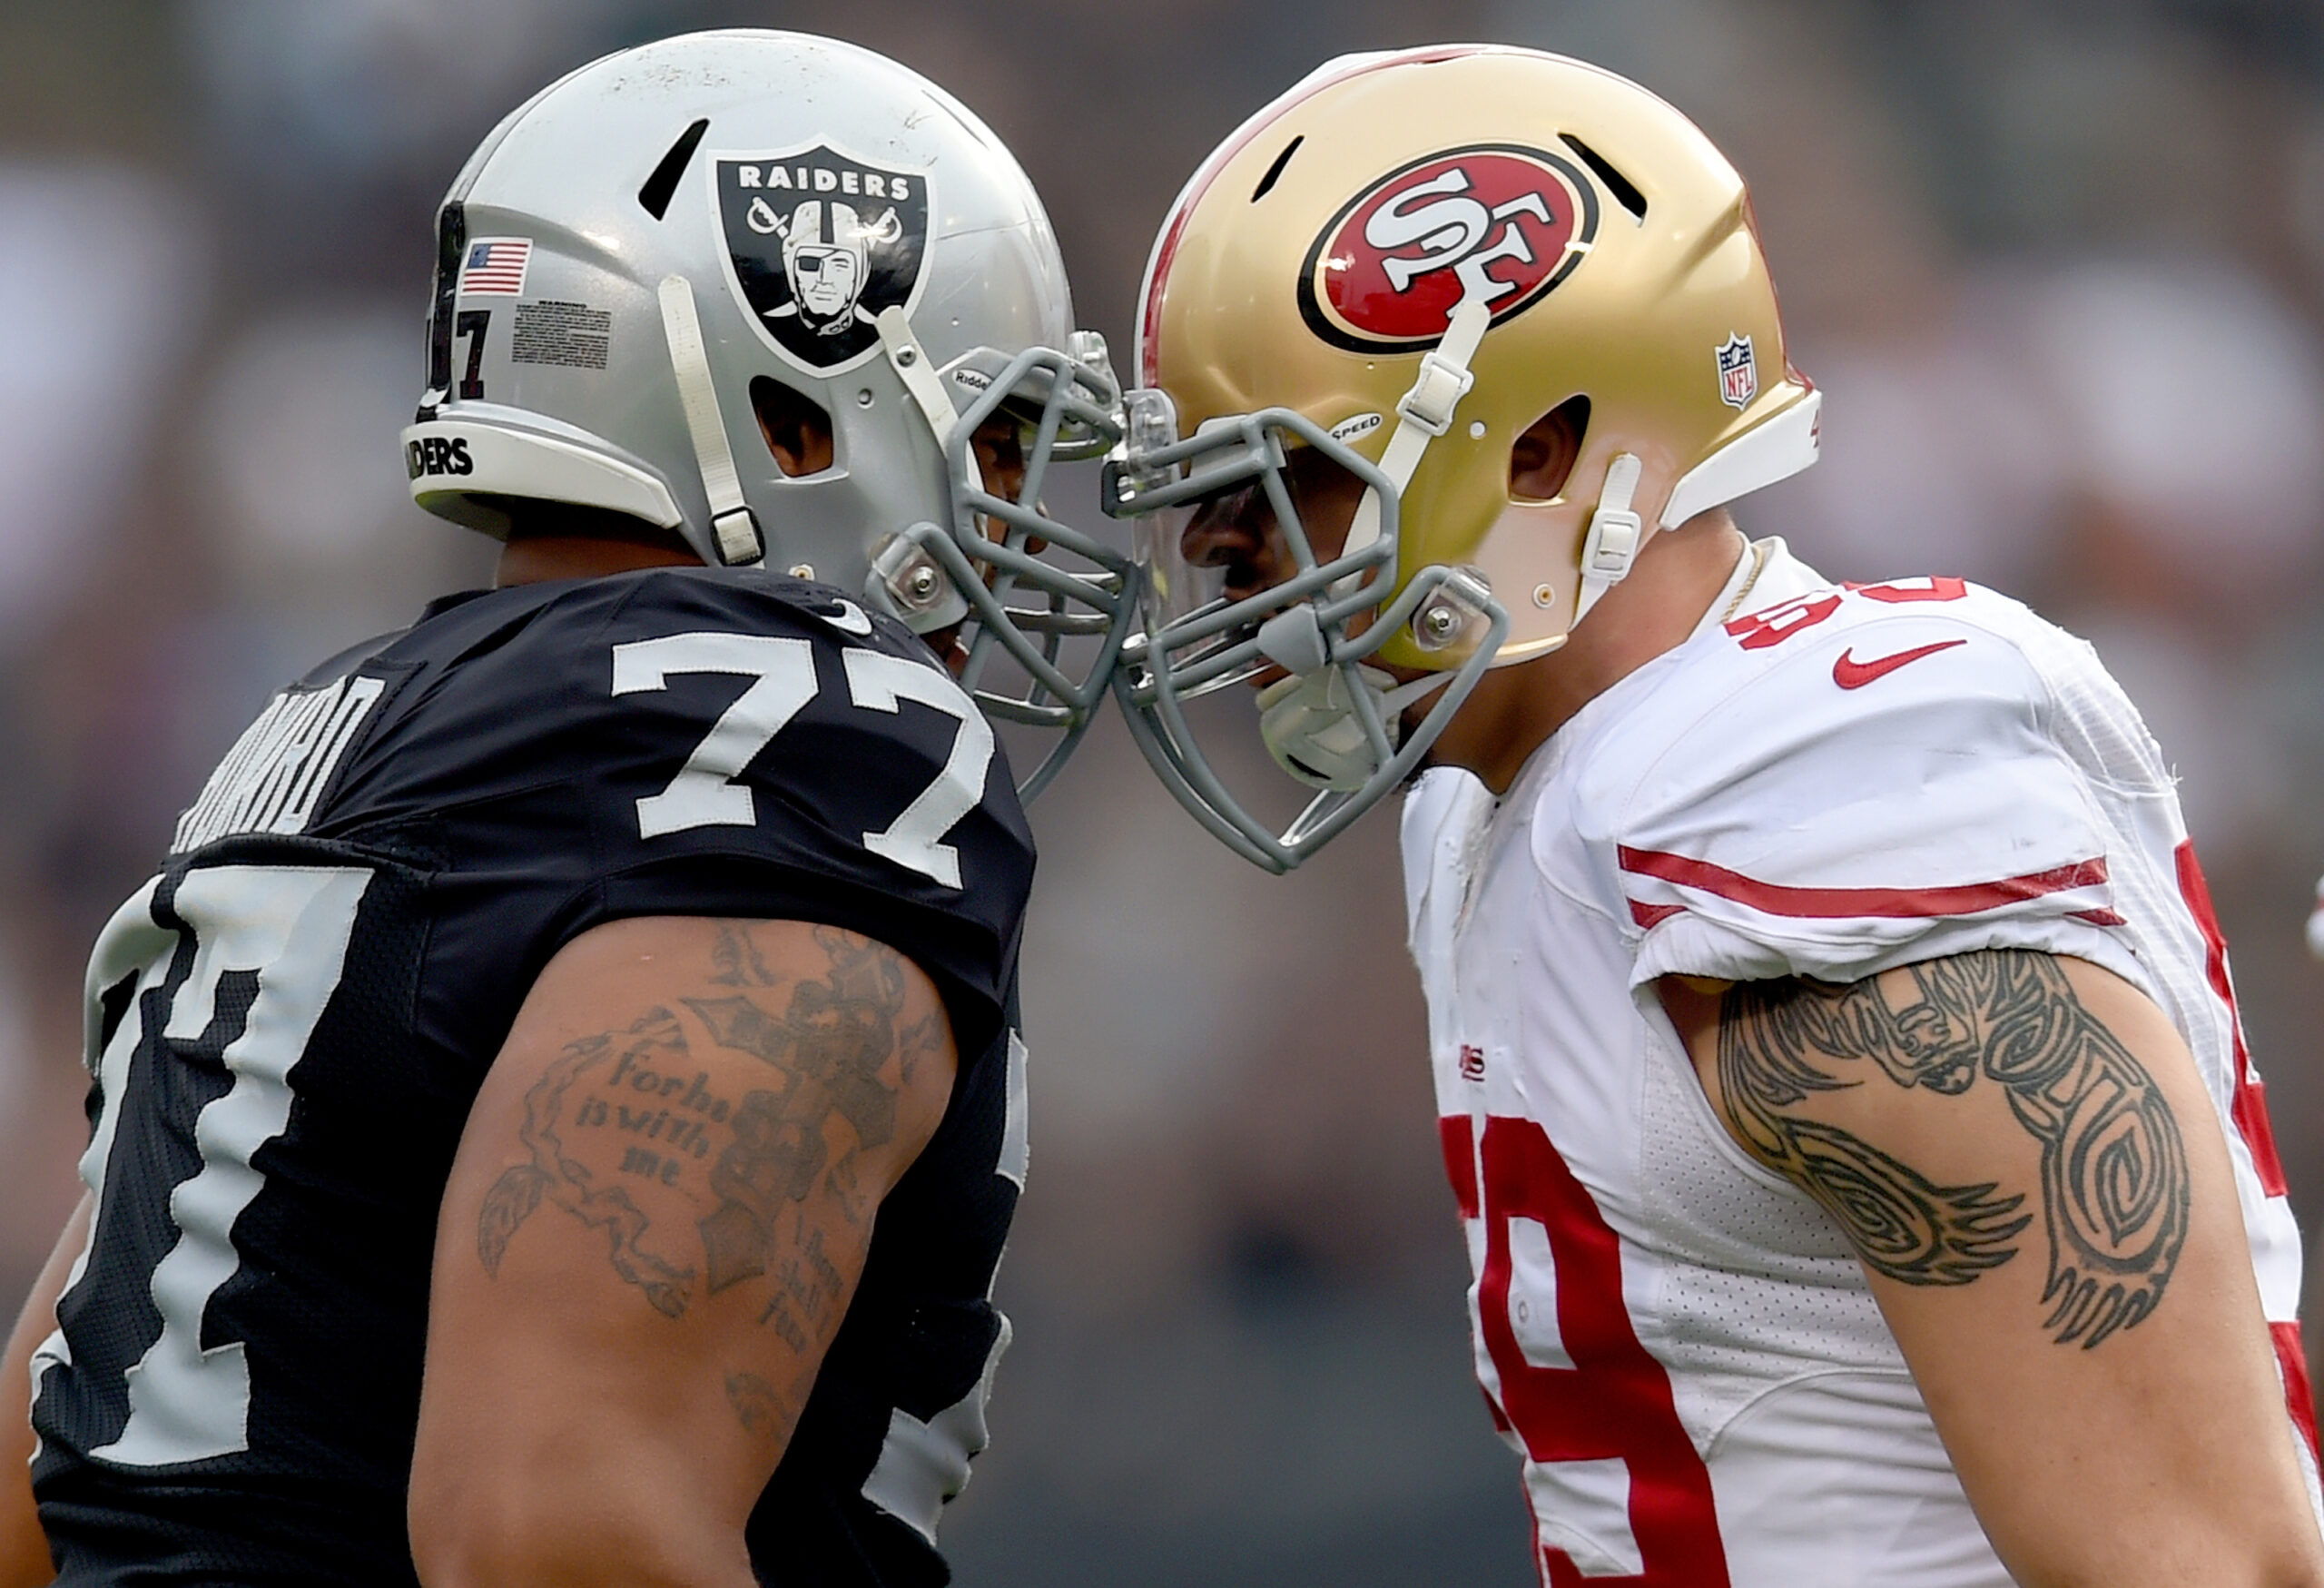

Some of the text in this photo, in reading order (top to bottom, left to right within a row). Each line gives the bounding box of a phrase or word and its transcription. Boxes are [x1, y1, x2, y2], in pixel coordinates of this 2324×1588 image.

[739, 165, 910, 202] RAIDERS
[1364, 167, 1552, 319] SF
[955, 371, 990, 391] Ridde
[1726, 366, 1754, 399] NFL
[1332, 416, 1381, 441] SPEED
[611, 632, 996, 891] 77
